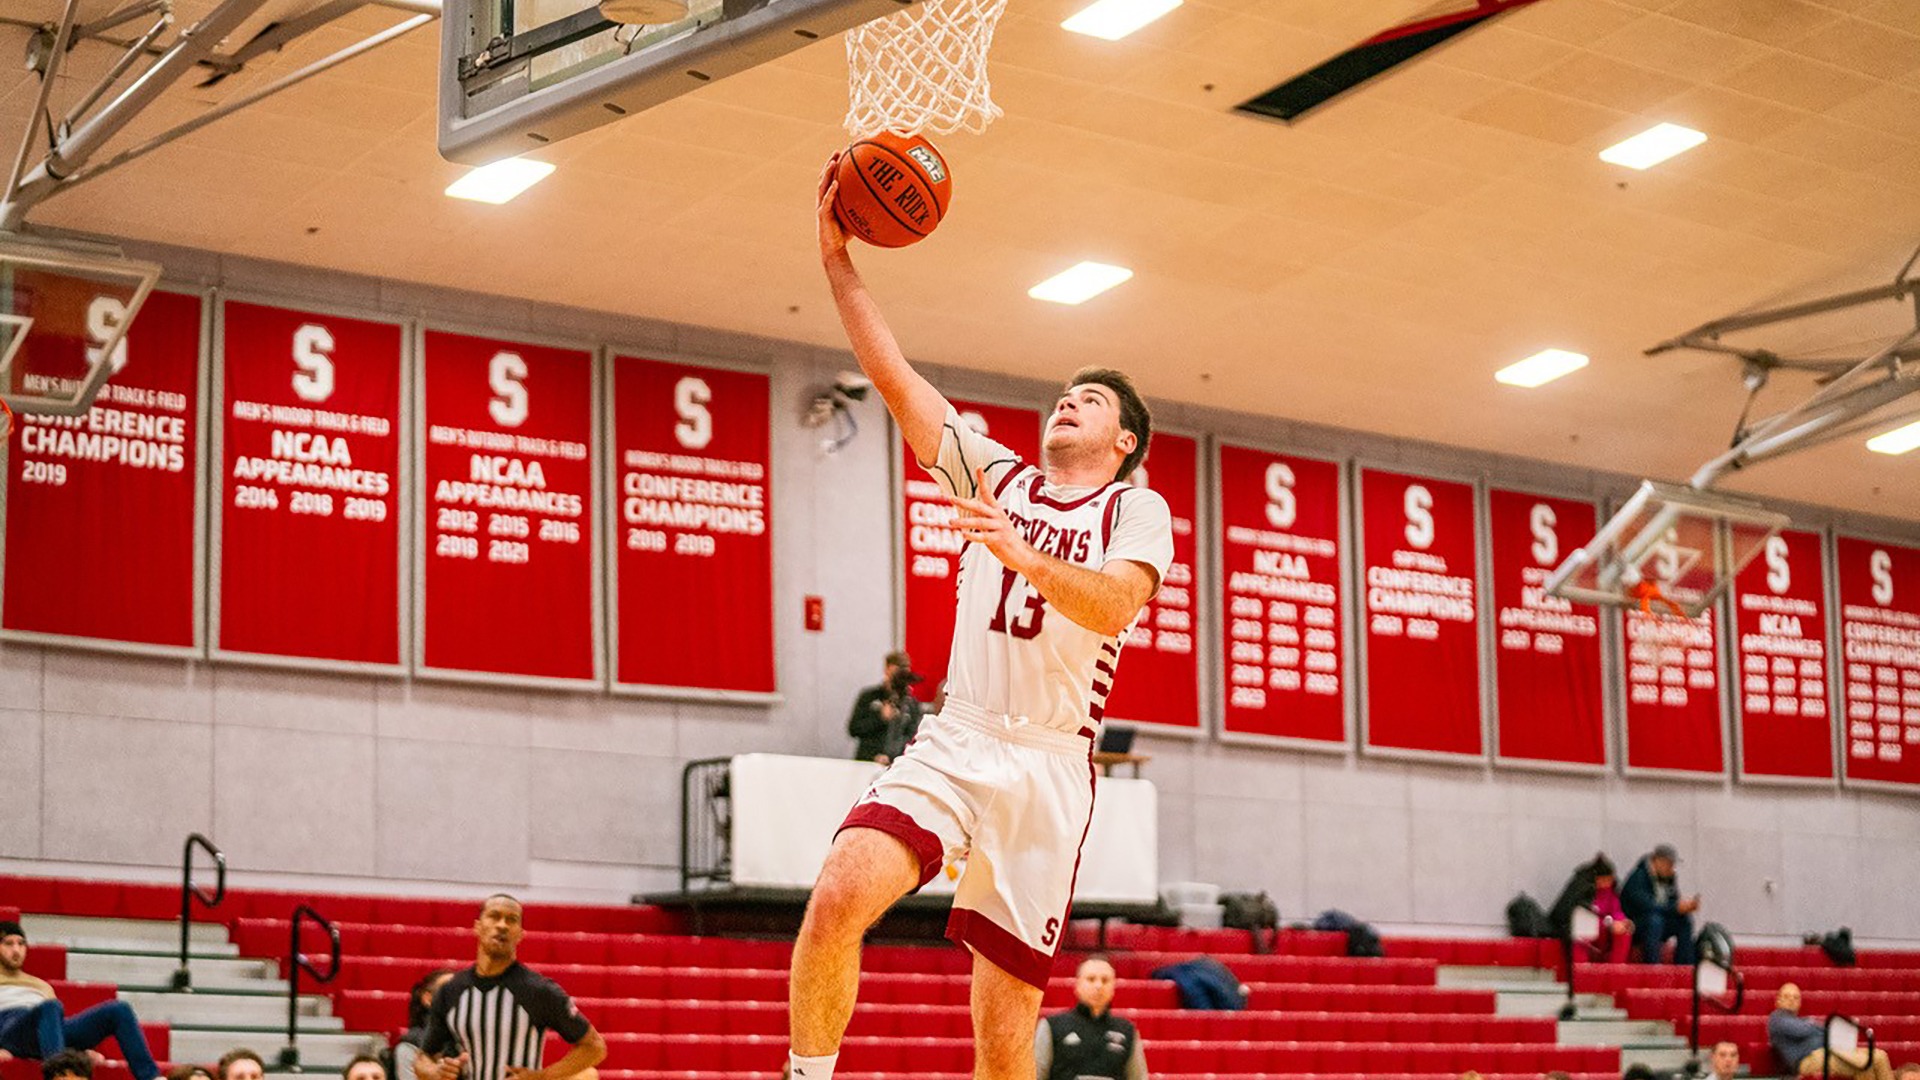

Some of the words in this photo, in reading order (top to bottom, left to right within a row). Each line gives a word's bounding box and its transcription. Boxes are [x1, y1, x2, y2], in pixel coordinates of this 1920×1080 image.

[868, 156, 905, 192] THE
[894, 183, 930, 226] ROCK
[85, 296, 128, 374] S
[291, 323, 335, 403] S
[23, 373, 60, 392] MEN'S
[112, 384, 146, 405] TRACK
[156, 390, 187, 412] FIELD
[488, 352, 529, 427] S
[23, 406, 186, 443] ERENCE
[233, 400, 271, 423] MEN'S
[271, 405, 313, 427] INDOOR
[314, 409, 349, 433] TRACK
[361, 416, 390, 438] FIELD
[674, 376, 712, 450] S
[21, 425, 185, 472] CHAMPIONS
[271, 430, 352, 467] NCAA
[429, 424, 466, 447] MEN'S
[560, 441, 587, 460] FIELD
[22, 460, 67, 486] 2019
[233, 456, 390, 496] APPEARANCES
[470, 453, 546, 489] NCAA
[234, 485, 279, 510] 2014
[435, 479, 583, 518] APPEARANCES
[624, 472, 764, 509] CONFERENCE
[1265, 462, 1296, 529] S
[437, 507, 479, 533] 2012
[624, 497, 765, 536] CHAMPIONS
[1404, 484, 1434, 550] S
[1530, 503, 1558, 566] S
[488, 540, 529, 564] 2021
[1253, 549, 1310, 581] NCAA
[1765, 534, 1791, 594] S
[1229, 571, 1336, 606] APPEARANCES
[1368, 566, 1473, 599] CONFERENCE
[1870, 550, 1893, 606] S
[989, 565, 1047, 640] 13
[1368, 586, 1474, 623] CHAMPIONS
[1500, 606, 1596, 637] APPEARANCES
[1759, 612, 1803, 638] NCAA
[1741, 634, 1824, 660] APPEARANCES
[1041, 917, 1059, 947] S
